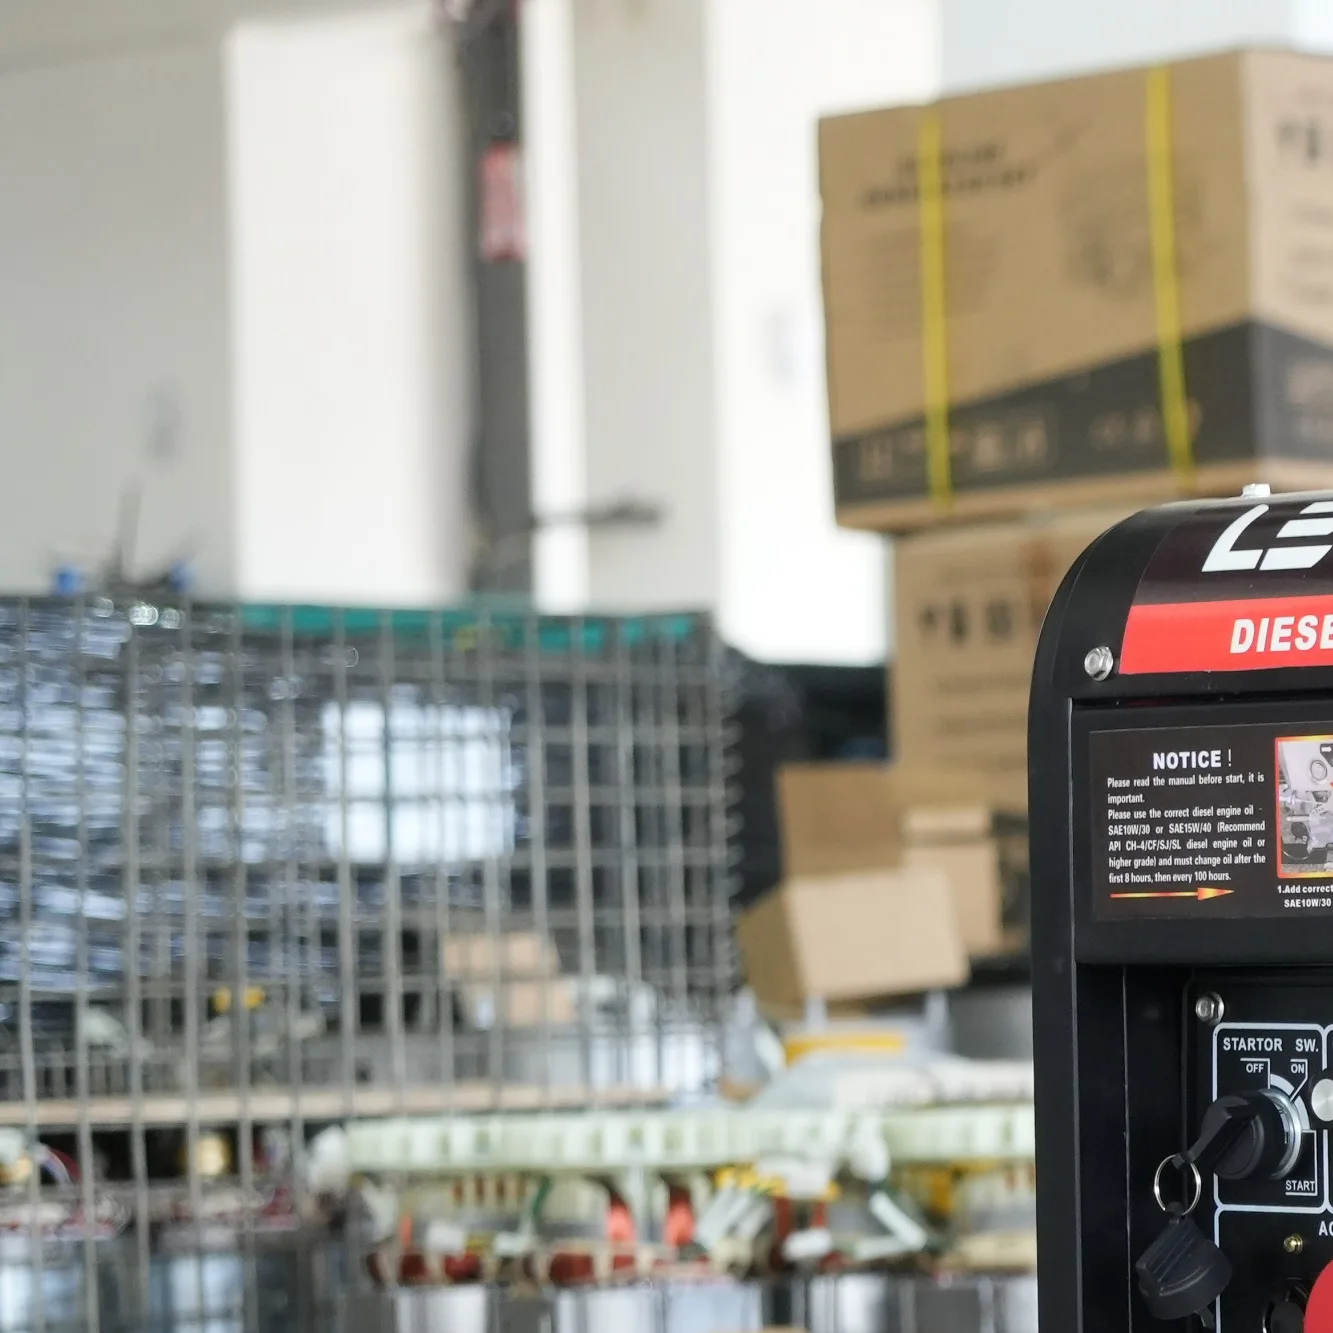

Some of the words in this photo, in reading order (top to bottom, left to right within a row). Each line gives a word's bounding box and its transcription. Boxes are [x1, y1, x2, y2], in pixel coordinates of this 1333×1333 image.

[1153, 750, 1221, 769] NOTICE
[1107, 777, 1130, 788] Please
[1134, 777, 1149, 787] read
[1153, 776, 1165, 786] the
[1169, 775, 1195, 785] manual
[1199, 774, 1222, 785] before
[1248, 772, 1254, 782] it
[1258, 772, 1264, 782] is
[1107, 794, 1145, 805] important.
[1108, 809, 1131, 820] Please
[1134, 810, 1146, 818] use
[1150, 808, 1161, 818] the
[1164, 807, 1189, 818] correct
[1192, 806, 1213, 817] diesel
[1217, 806, 1241, 818] engine
[1244, 805, 1253, 815] oil
[1108, 824, 1150, 835] SAE10W/30
[1156, 826, 1163, 834] or
[1169, 822, 1211, 834] SAE15W/40
[1218, 821, 1265, 832] (Recommend
[1109, 841, 1121, 851] API
[1186, 839, 1208, 849] diesel
[1213, 838, 1237, 850] engine
[1243, 837, 1252, 848] oil
[1257, 838, 1265, 847] or
[1109, 857, 1131, 869] higher
[1134, 857, 1156, 868] grade)
[1159, 856, 1171, 866] and
[1174, 856, 1192, 865] must
[1195, 855, 1221, 867] change
[1223, 854, 1232, 864] oil
[1234, 853, 1251, 864] after
[1254, 853, 1265, 863] the
[1109, 873, 1123, 883] first
[1125, 873, 1129, 882] 8
[1131, 872, 1153, 883] hours,
[1155, 872, 1171, 881] then
[1173, 872, 1192, 883] every
[1194, 871, 1207, 881] 100
[1209, 871, 1231, 880] hours.
[1277, 885, 1301, 894] 1.Add
[1302, 884, 1333, 893] correct
[1284, 898, 1331, 908] SAE10W/30
[1223, 1038, 1283, 1051] STARTOR
[1295, 1039, 1319, 1052] SW.
[1246, 1063, 1264, 1073] OFF
[1290, 1064, 1305, 1073] ON
[1286, 1180, 1315, 1191] START
